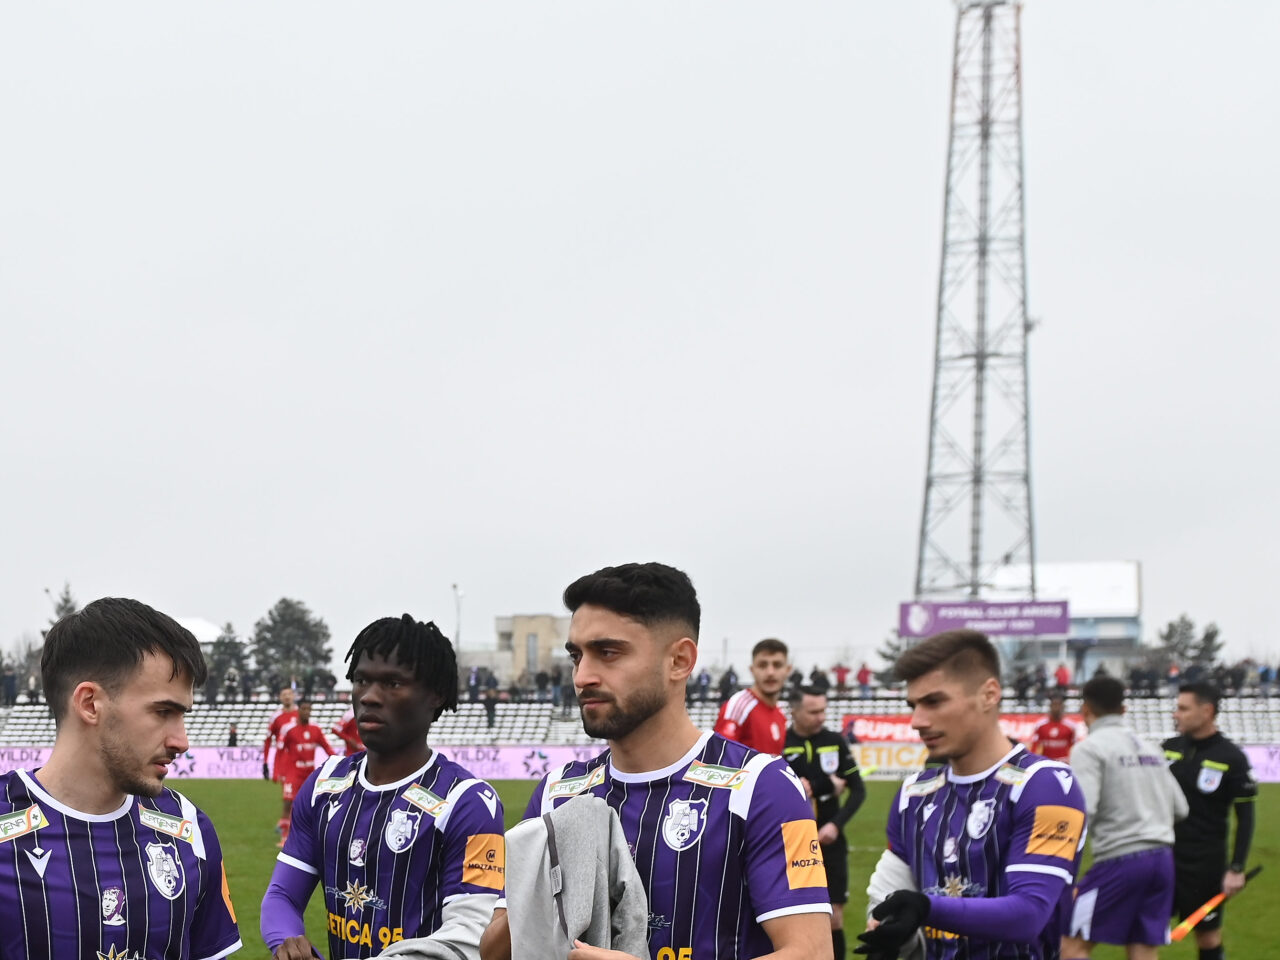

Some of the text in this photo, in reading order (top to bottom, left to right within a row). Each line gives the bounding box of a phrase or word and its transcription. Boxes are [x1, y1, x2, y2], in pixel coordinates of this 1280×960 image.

[218, 750, 263, 762] YILDIZ
[451, 749, 500, 761] YILDIZ
[692, 767, 730, 780] CATENA
[142, 812, 179, 830] CATENA
[327, 912, 405, 950] ETICA 95
